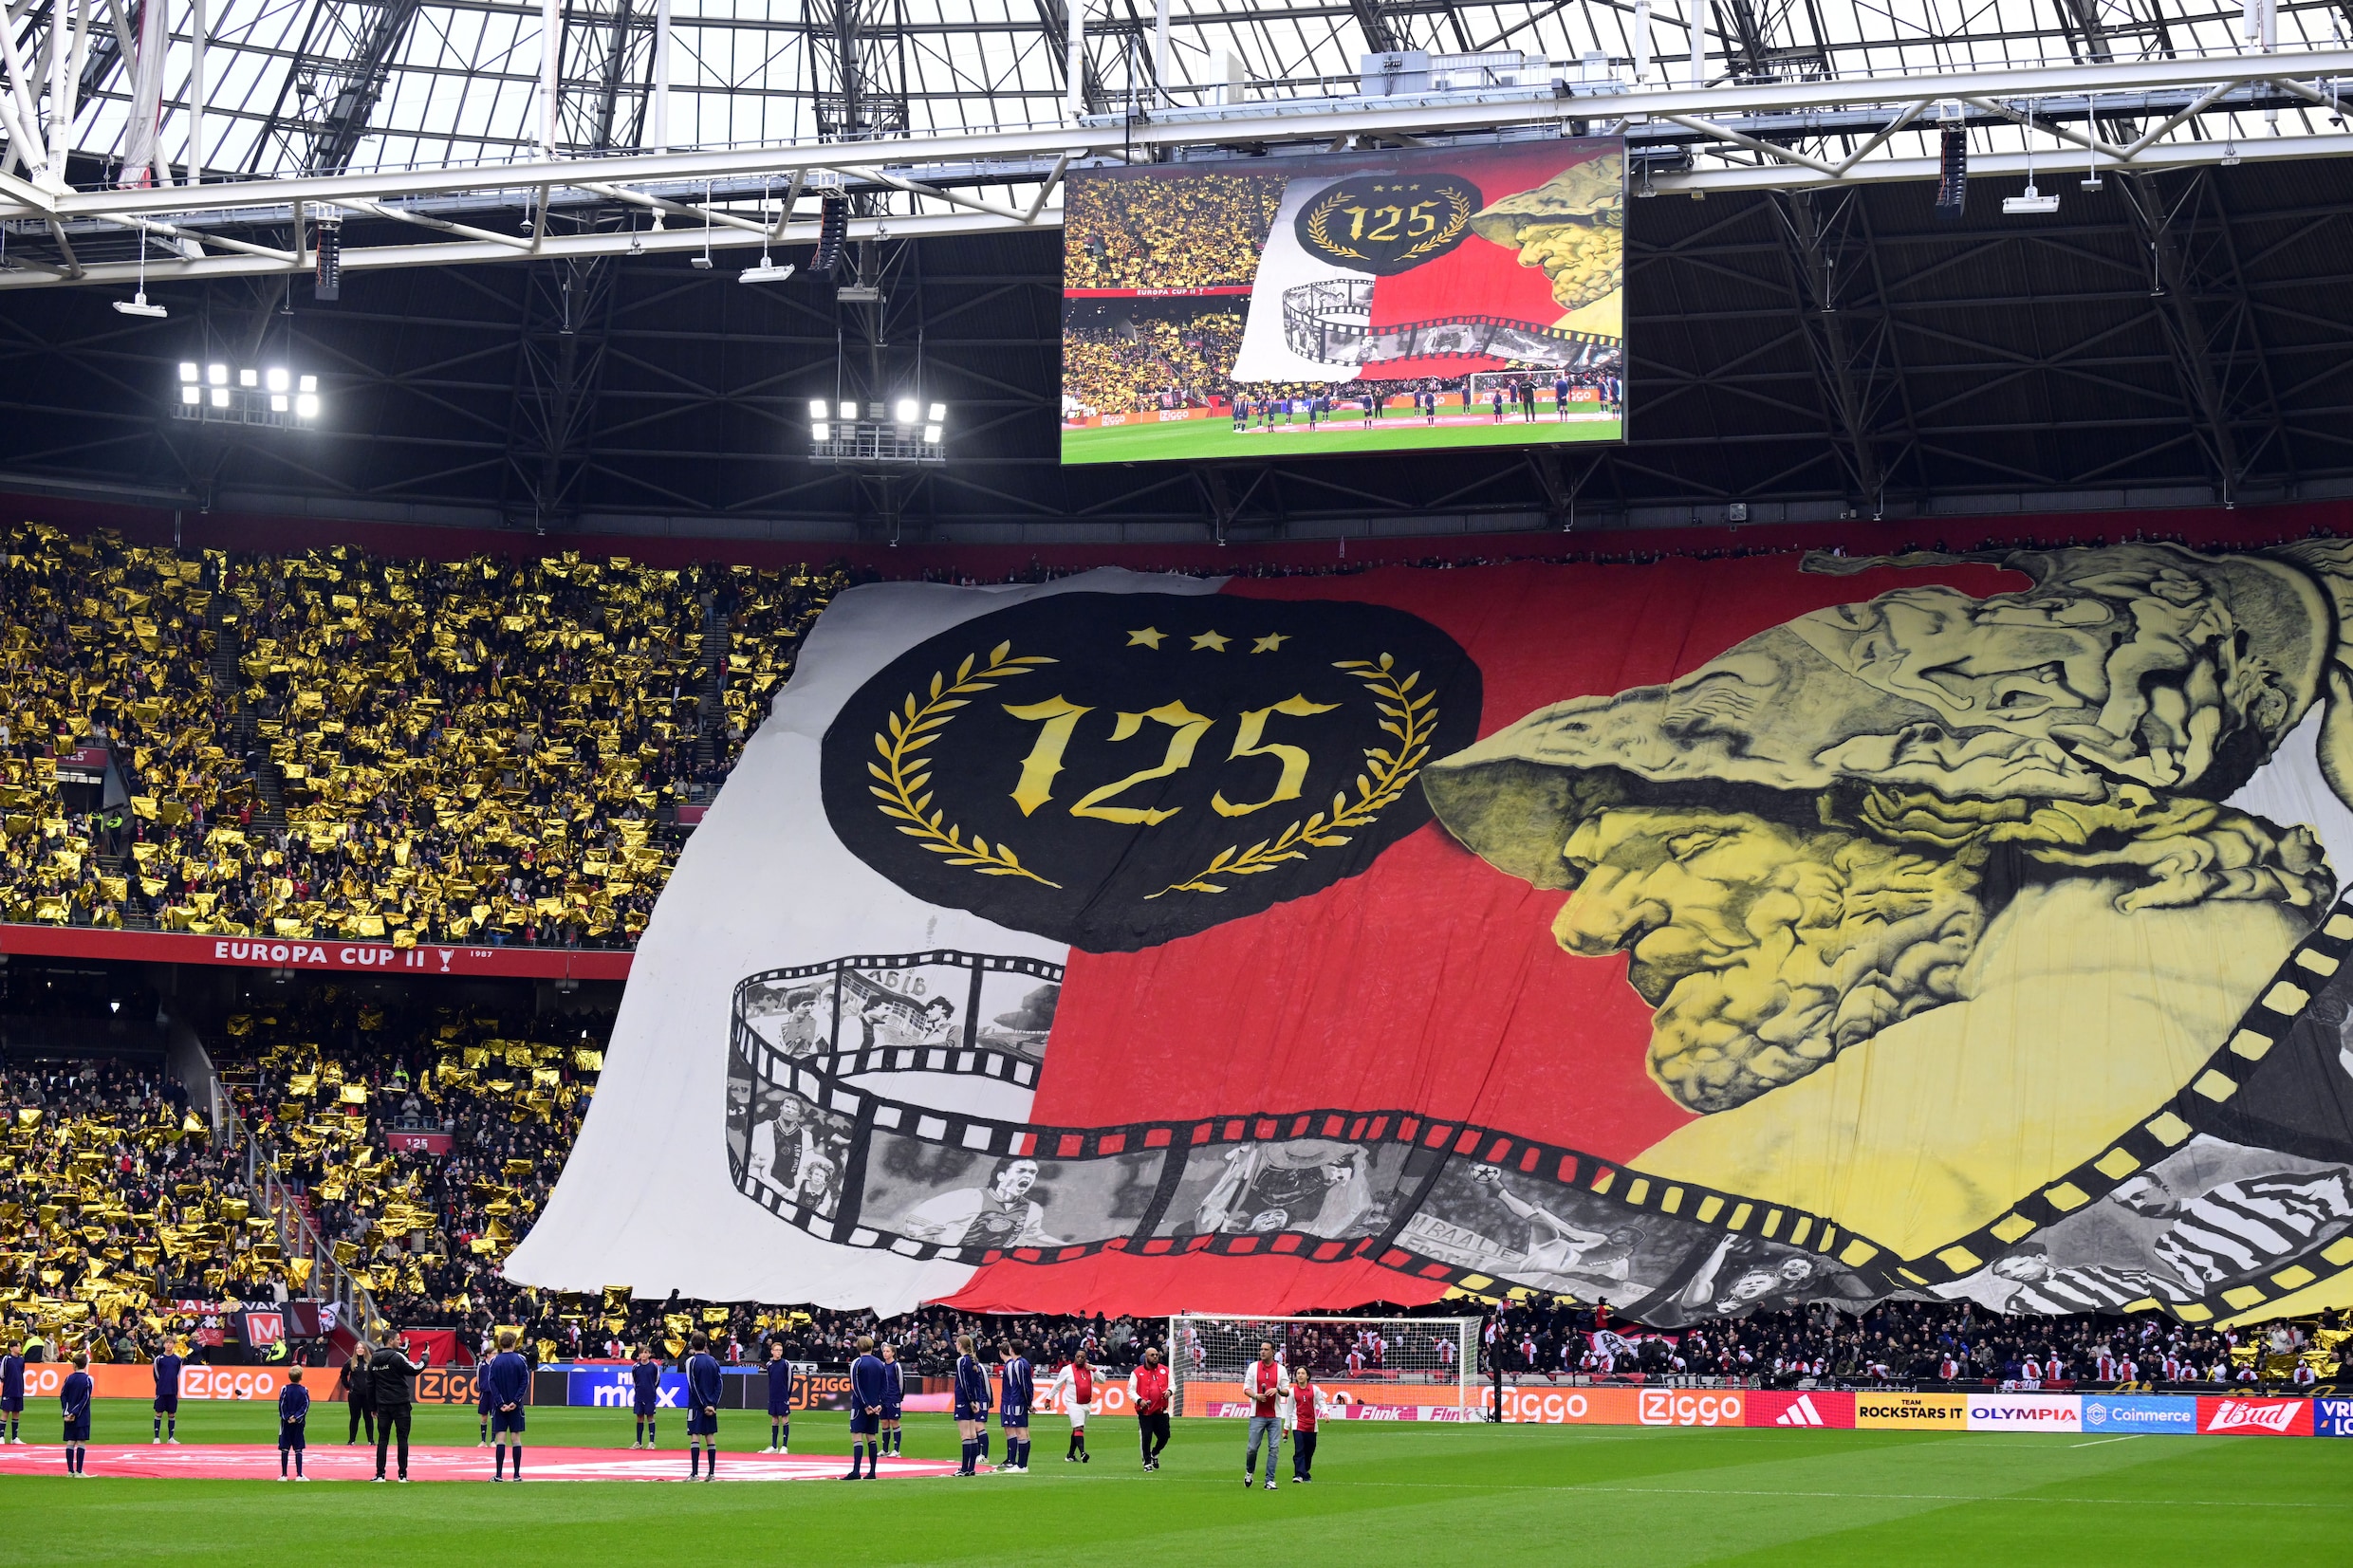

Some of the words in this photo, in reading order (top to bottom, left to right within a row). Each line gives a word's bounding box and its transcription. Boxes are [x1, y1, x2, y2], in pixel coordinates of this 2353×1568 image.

[1342, 200, 1441, 241] 125
[1002, 693, 1343, 826] 125
[214, 941, 328, 964] EUROPA
[340, 948, 395, 967] CUP
[405, 950, 424, 968] II
[405, 1138, 428, 1149] 125
[251, 1318, 279, 1339] M
[811, 1377, 854, 1393] ZIGG
[594, 1385, 680, 1408] mx
[1218, 1403, 1251, 1417] Flin
[1360, 1405, 1401, 1420] Flink
[1430, 1406, 1472, 1421] Flink
[1860, 1407, 1946, 1419] ROCKSTARS
[1950, 1408, 1963, 1419] IT
[1971, 1408, 2078, 1422] OLYMPIA
[2112, 1407, 2191, 1423] Coinmerce
[2218, 1402, 2285, 1424] Bud
